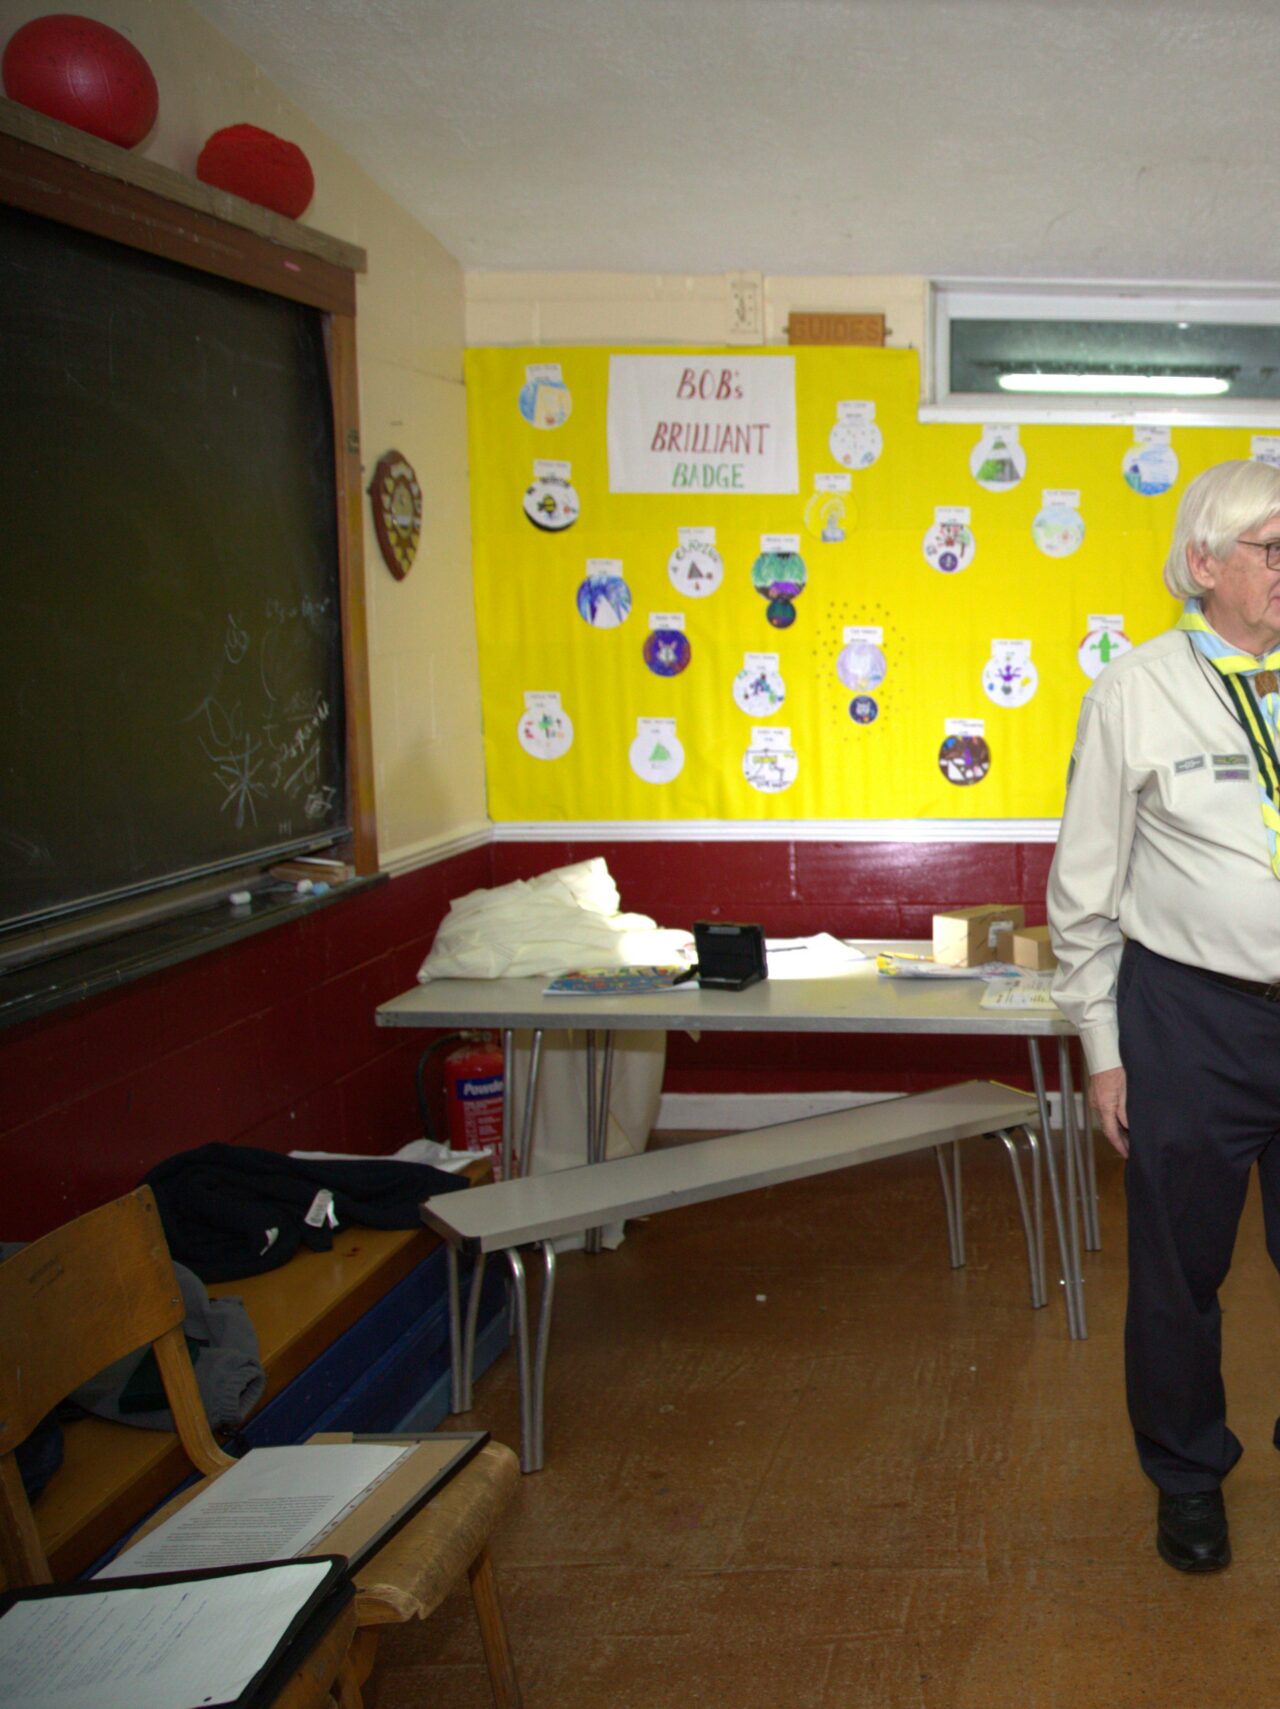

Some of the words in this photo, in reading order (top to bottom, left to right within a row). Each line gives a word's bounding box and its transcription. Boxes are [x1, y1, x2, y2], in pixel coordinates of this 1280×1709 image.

[793, 317, 879, 341] GUIDES
[651, 421, 771, 455] BRILLIANT
[672, 462, 745, 489] BADGE
